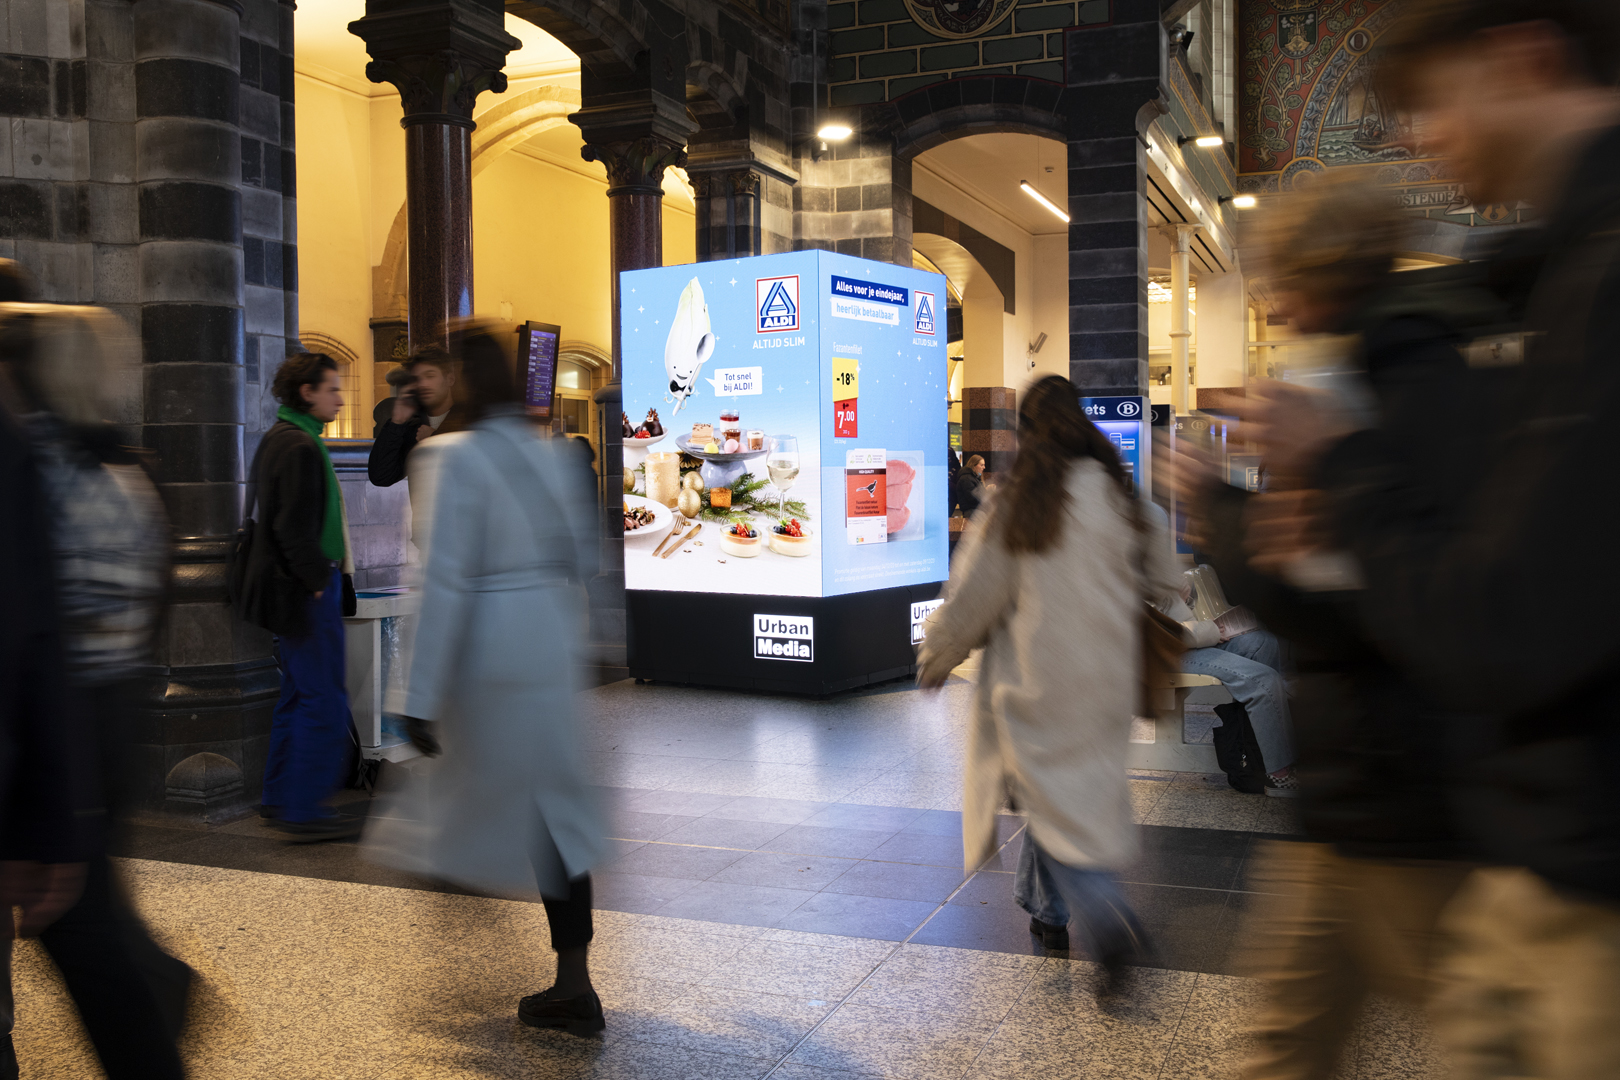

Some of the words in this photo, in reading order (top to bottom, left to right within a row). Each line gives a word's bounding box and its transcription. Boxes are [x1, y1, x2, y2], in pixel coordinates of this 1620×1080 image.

[836, 281, 852, 293] Alles
[853, 285, 867, 296] voor
[867, 286, 875, 298] je
[875, 287, 905, 303] eindejaar,
[836, 303, 861, 318] heerlijk
[862, 307, 894, 321] betaalbaar
[763, 316, 793, 328] ALDI
[917, 321, 933, 331] ALDI
[752, 339, 782, 350] ALTIJD
[784, 337, 805, 348] SLIM
[833, 342, 862, 355] Fazantenfilet
[912, 337, 925, 346] ALTIJD
[925, 338, 938, 348] SLIM
[724, 372, 735, 381] Tot
[736, 372, 752, 381] snel
[836, 372, 855, 385] -18%
[723, 383, 732, 393] bij
[733, 381, 753, 391] ALDI!
[837, 411, 855, 429] 7.00
[758, 618, 809, 635] Urban
[757, 638, 810, 657] Media
